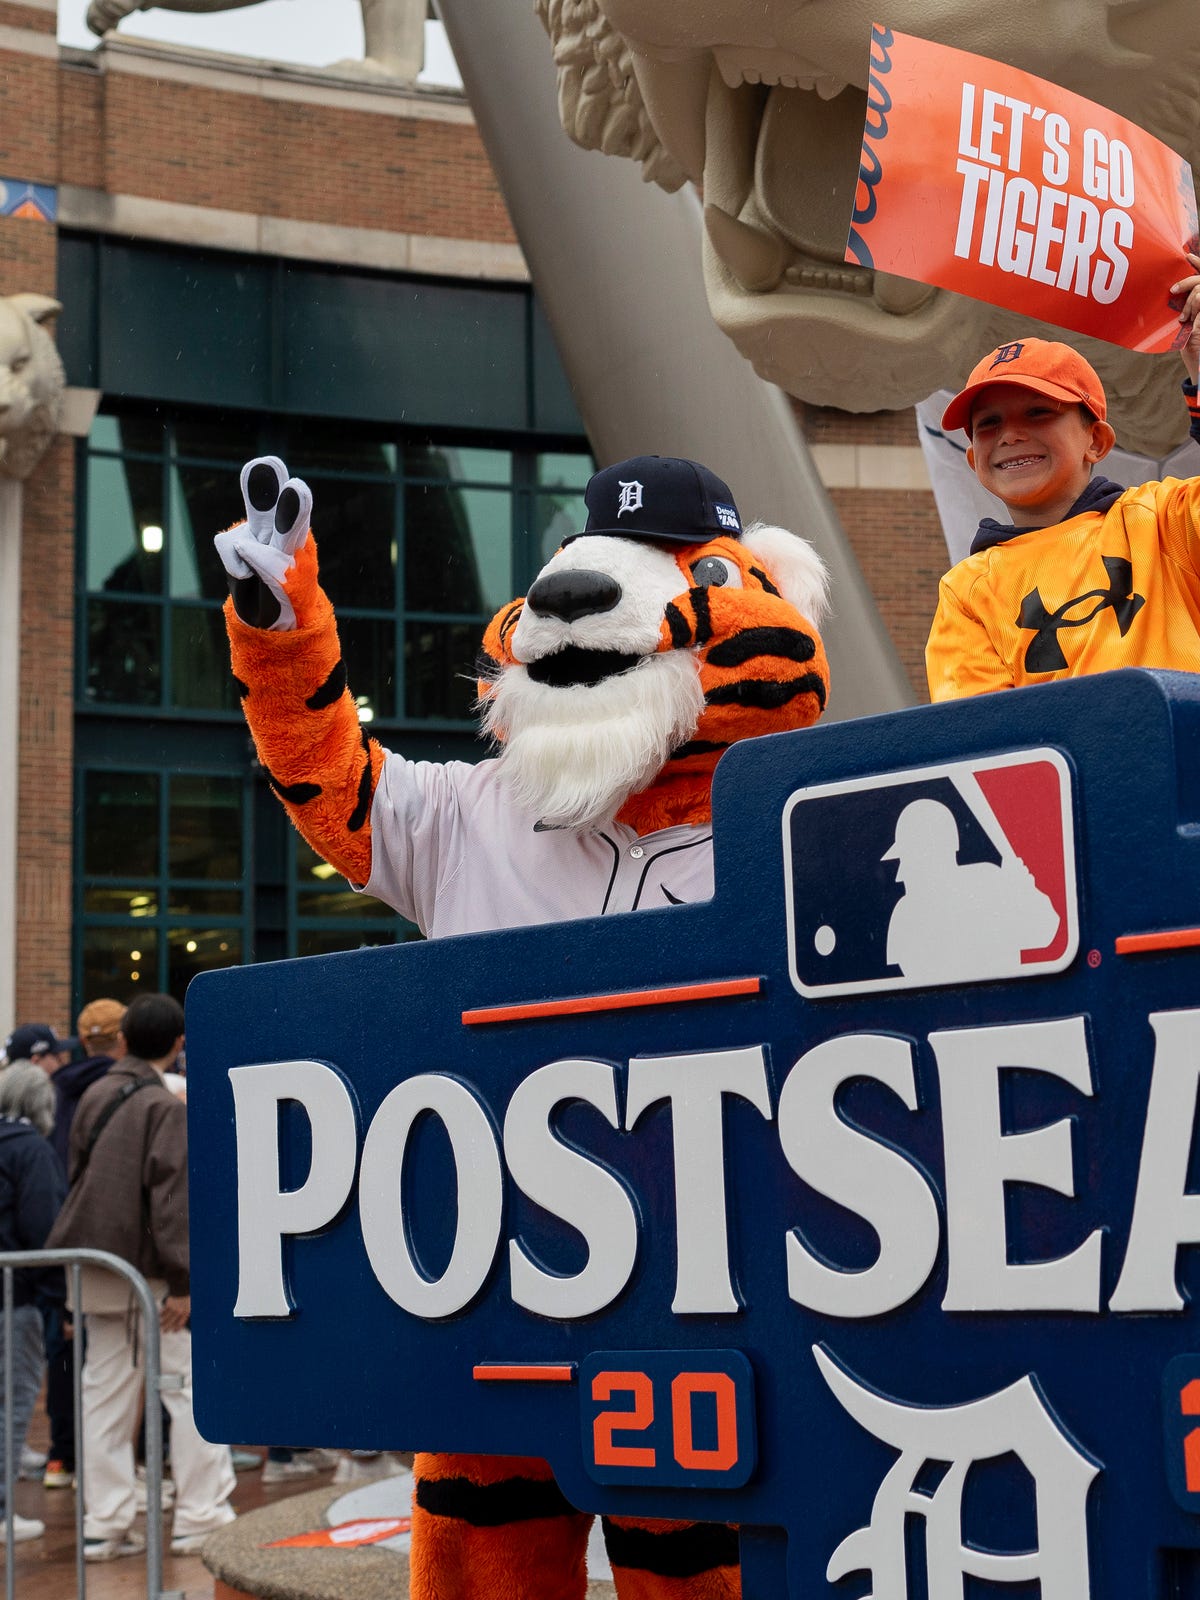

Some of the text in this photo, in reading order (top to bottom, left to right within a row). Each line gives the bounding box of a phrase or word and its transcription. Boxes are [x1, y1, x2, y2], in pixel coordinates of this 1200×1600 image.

[958, 82, 1135, 208] LET'S GO
[954, 158, 1134, 305] TIGERS
[591, 1371, 739, 1472] 20
